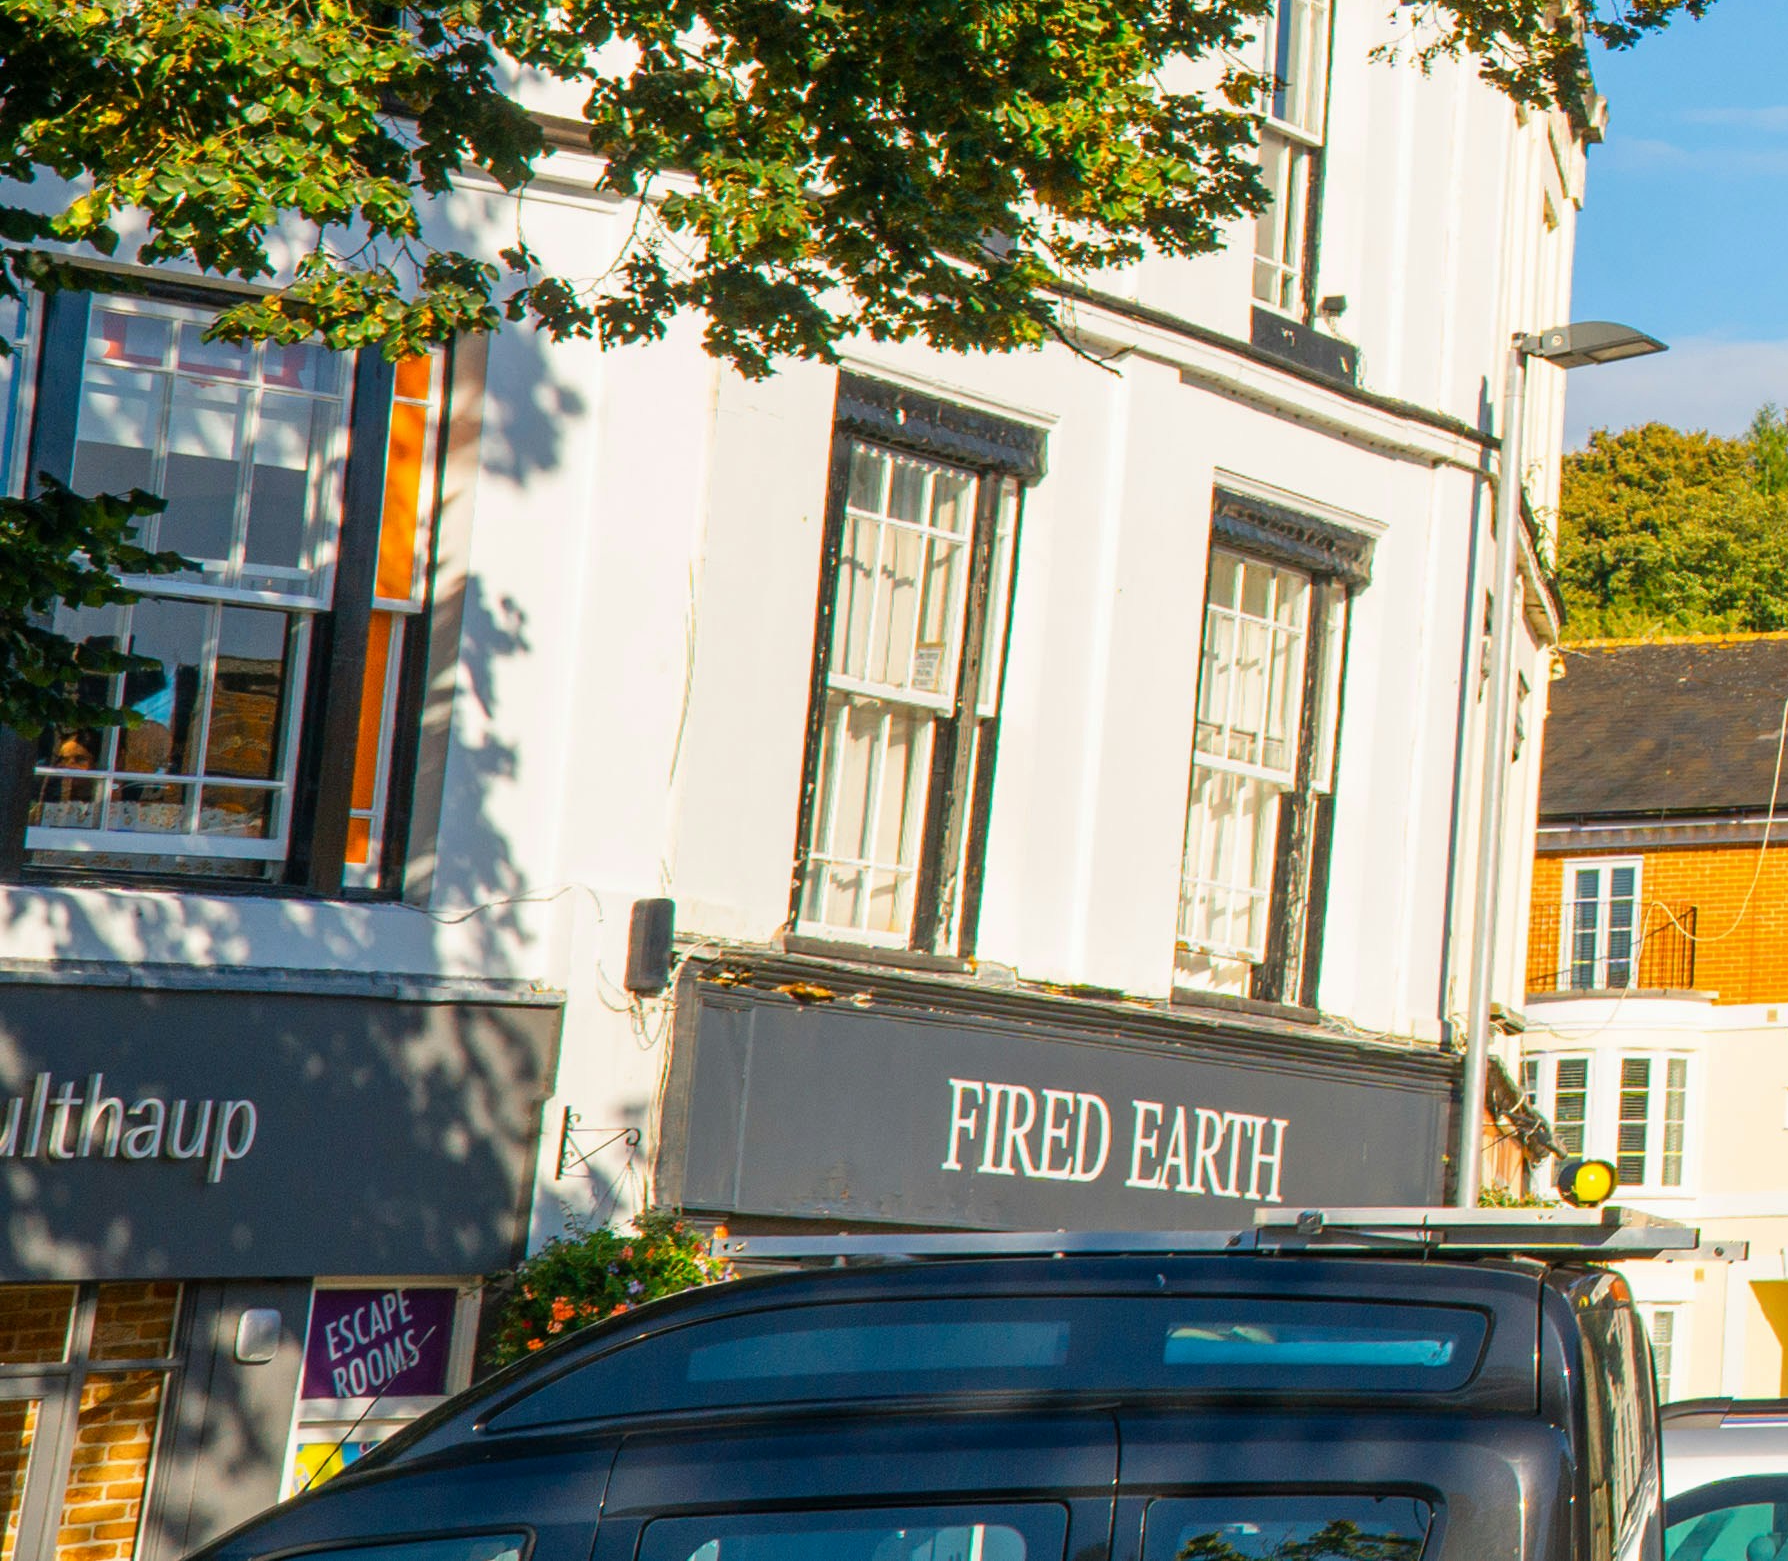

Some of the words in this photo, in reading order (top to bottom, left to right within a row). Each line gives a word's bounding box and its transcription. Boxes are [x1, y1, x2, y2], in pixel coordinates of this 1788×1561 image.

[941, 1077, 1113, 1184] FIRED
[1124, 1099, 1290, 1204] EARTH
[325, 1289, 413, 1361] ESCAPE
[332, 1328, 420, 1398] ROOMS
